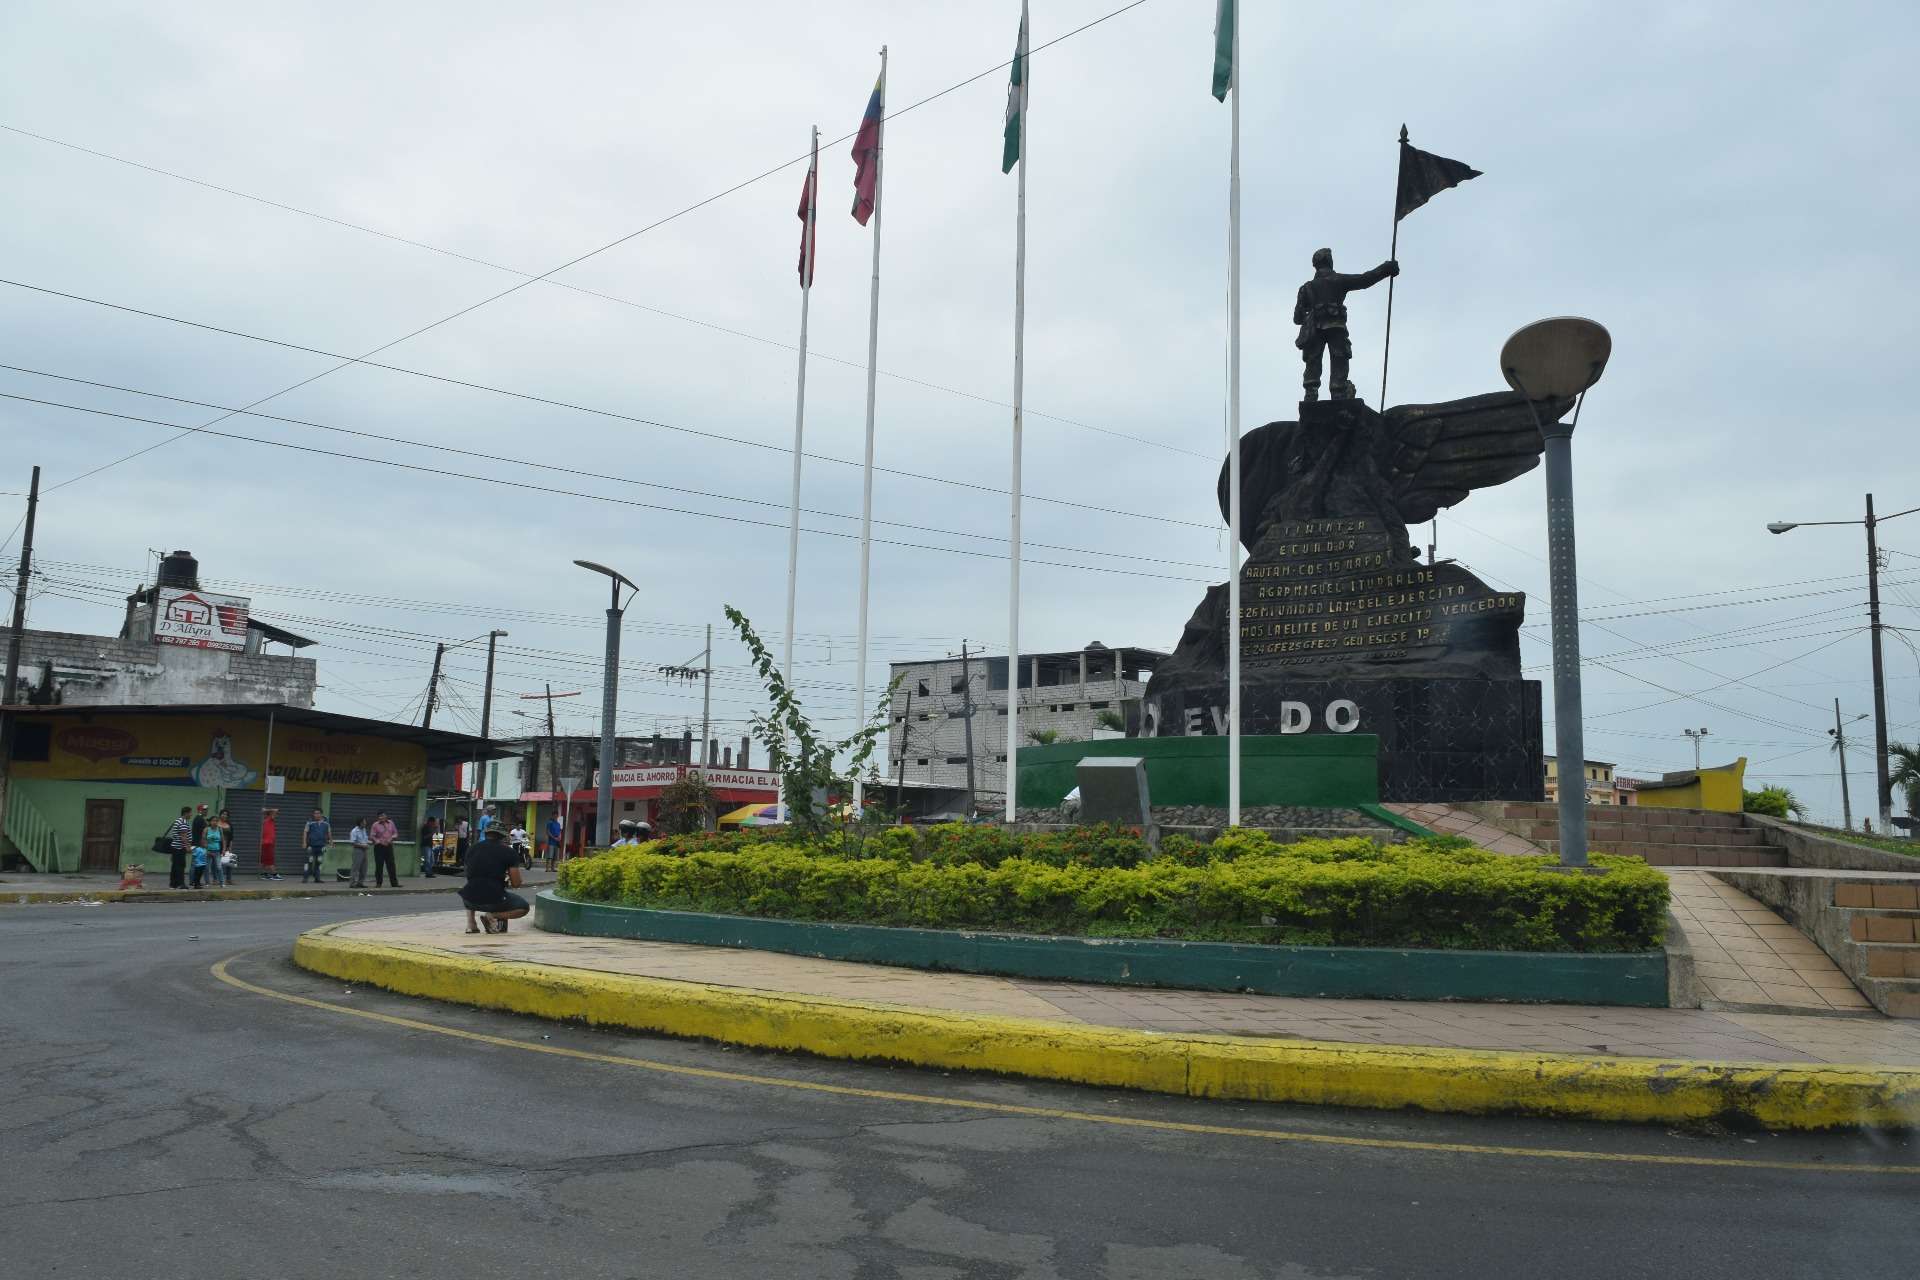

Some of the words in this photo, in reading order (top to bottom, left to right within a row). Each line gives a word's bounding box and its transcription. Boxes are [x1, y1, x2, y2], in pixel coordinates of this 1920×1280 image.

[1387, 585, 1465, 606] EJERCITO
[1284, 622, 1318, 635] ELITE
[1367, 609, 1432, 627] EJERCITO
[1442, 596, 1516, 615] VENCEDOR
[705, 773, 755, 786] ARMACIA
